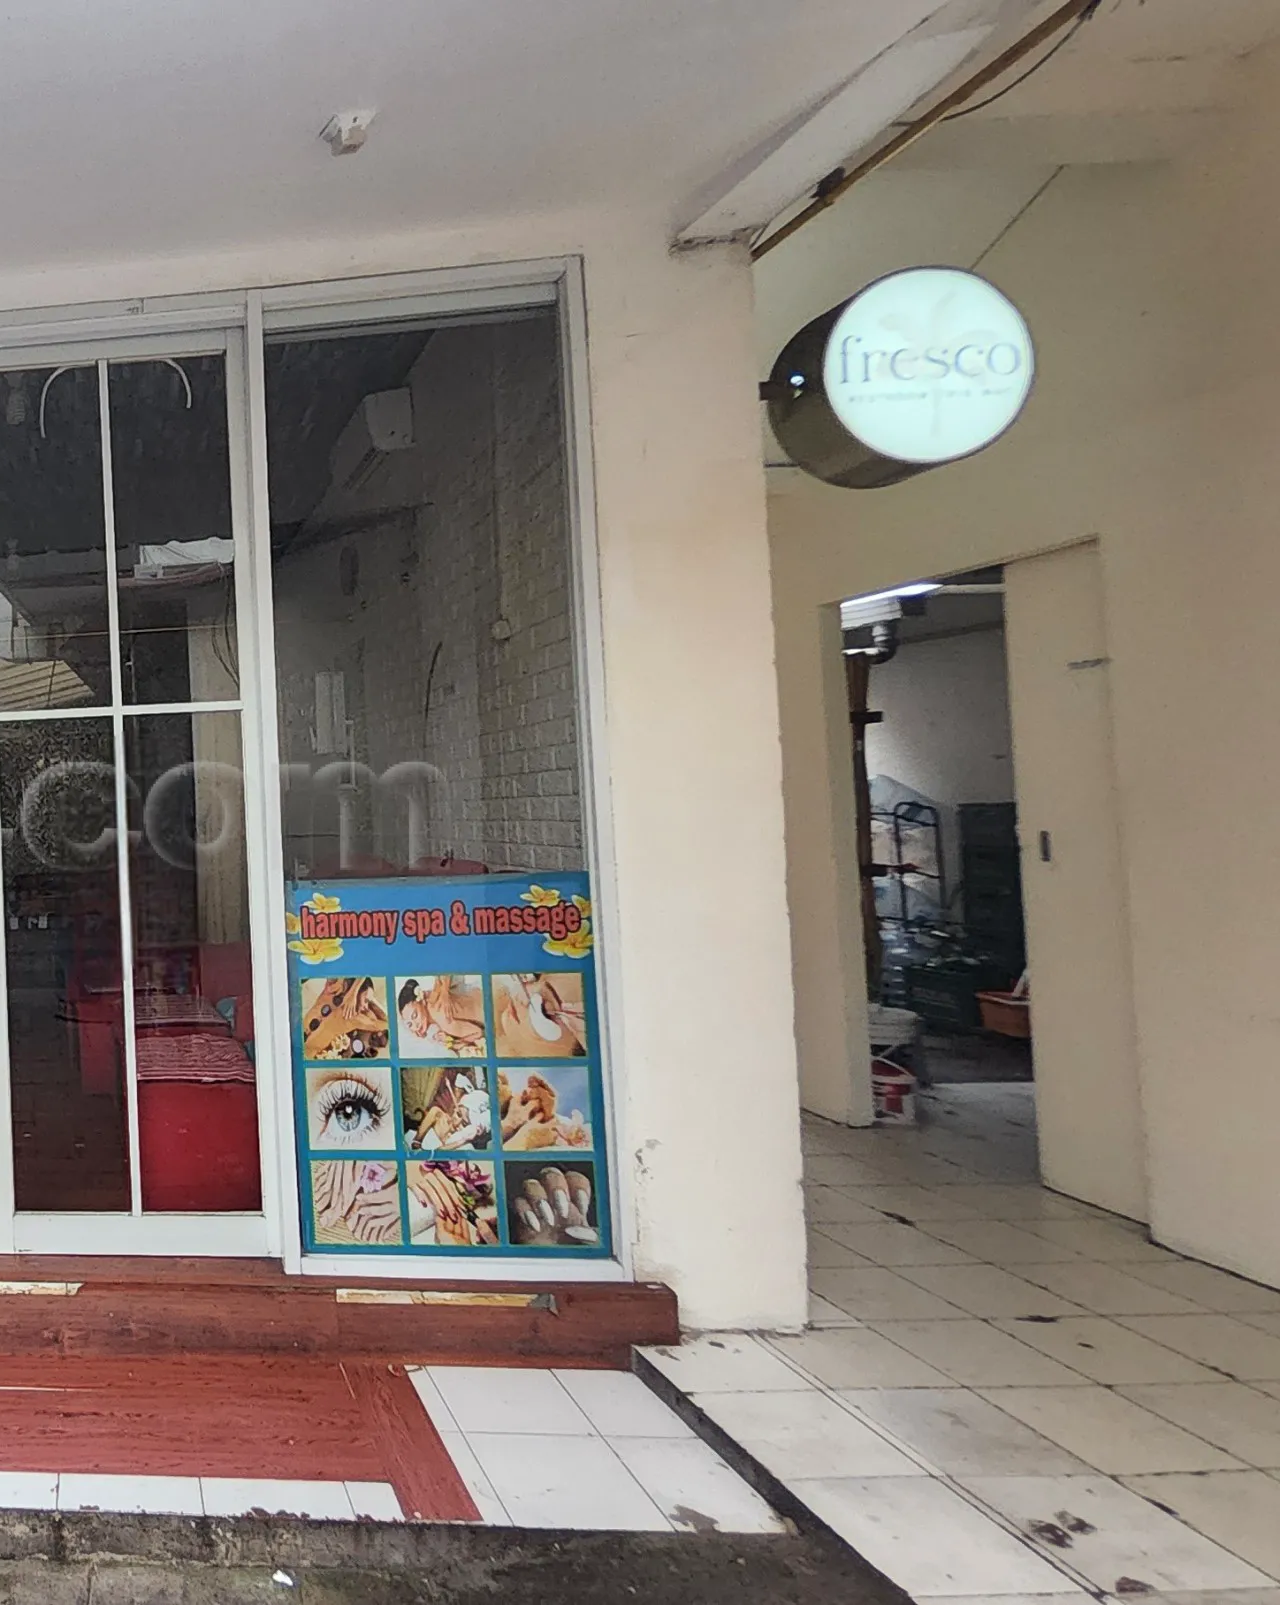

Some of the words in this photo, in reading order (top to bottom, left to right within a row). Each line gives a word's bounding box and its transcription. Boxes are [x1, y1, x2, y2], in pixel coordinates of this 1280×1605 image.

[839, 335, 1021, 384] fresco
[300, 905, 399, 945] harmony
[401, 908, 445, 944] spa
[450, 900, 471, 936] &
[474, 900, 581, 941] massage
